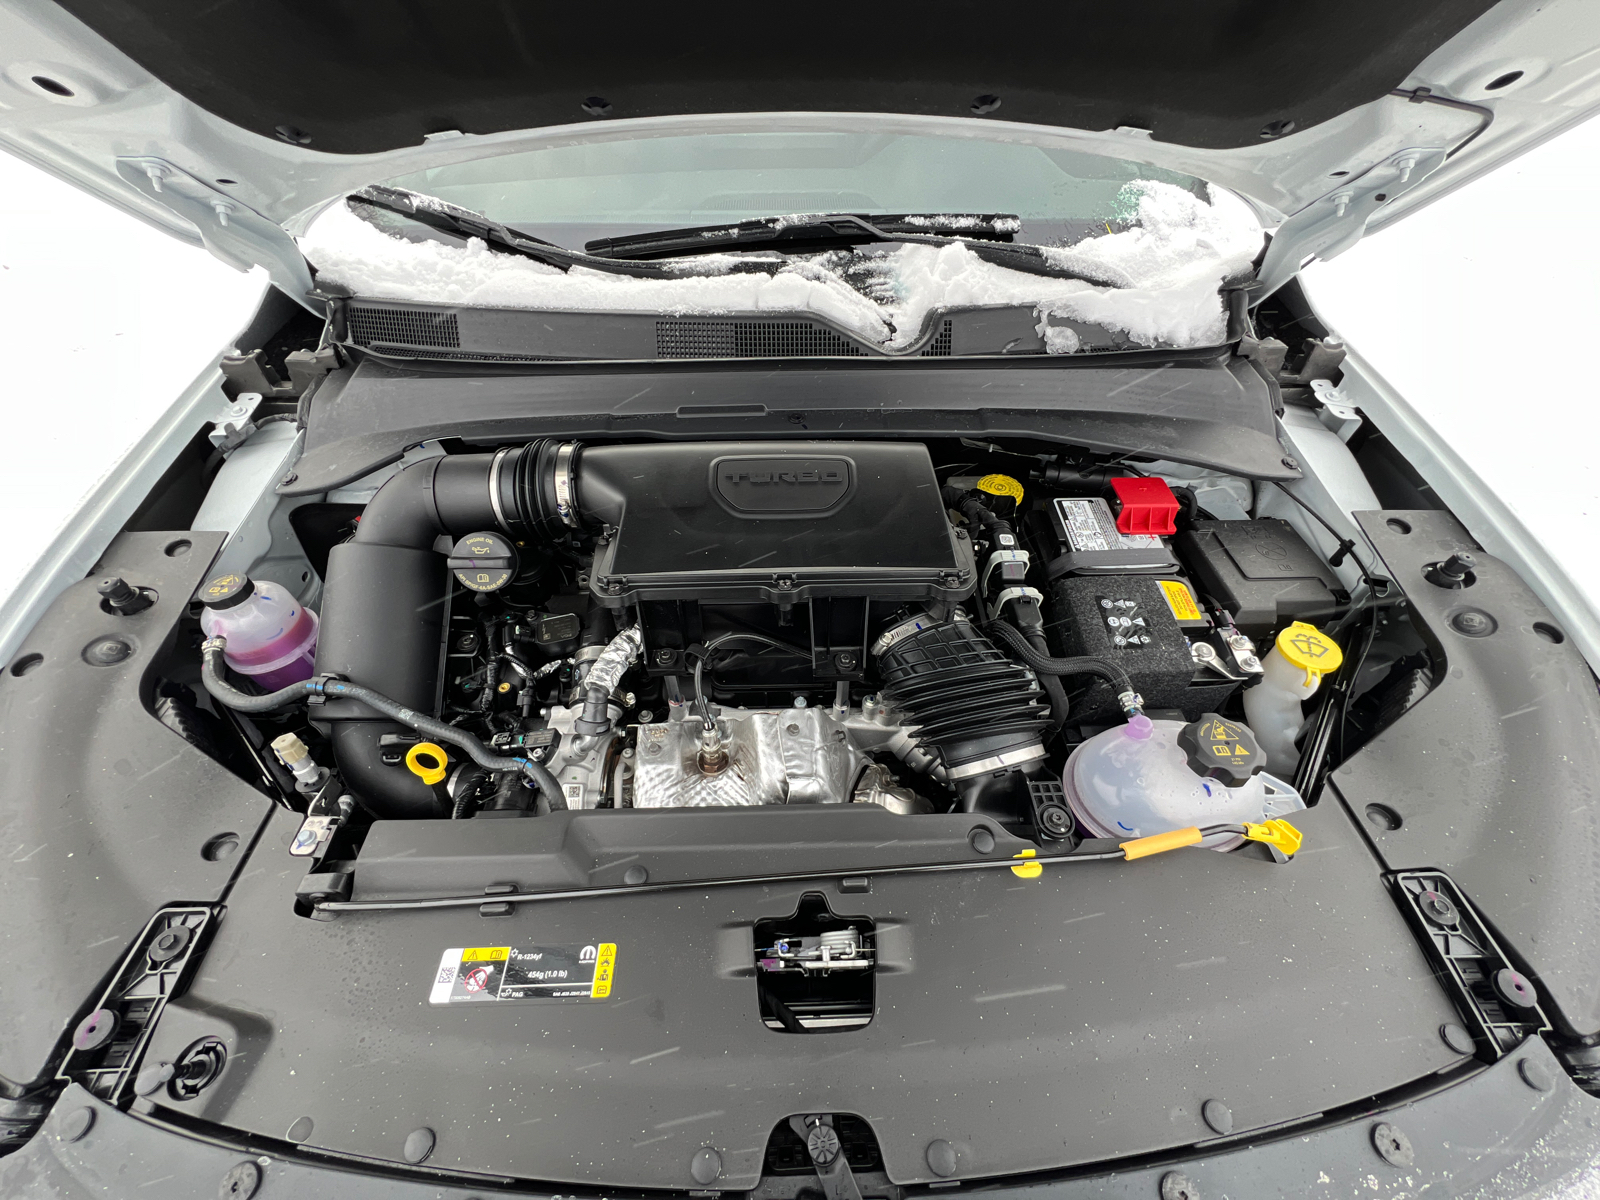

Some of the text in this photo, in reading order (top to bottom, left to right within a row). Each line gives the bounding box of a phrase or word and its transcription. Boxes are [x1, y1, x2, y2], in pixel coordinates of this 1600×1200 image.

[724, 470, 843, 484] TURBO
[466, 537, 494, 545] ENGINE OIL
[517, 953, 543, 961] R-1234yf
[527, 969, 568, 980] 454g (1.0 lb)
